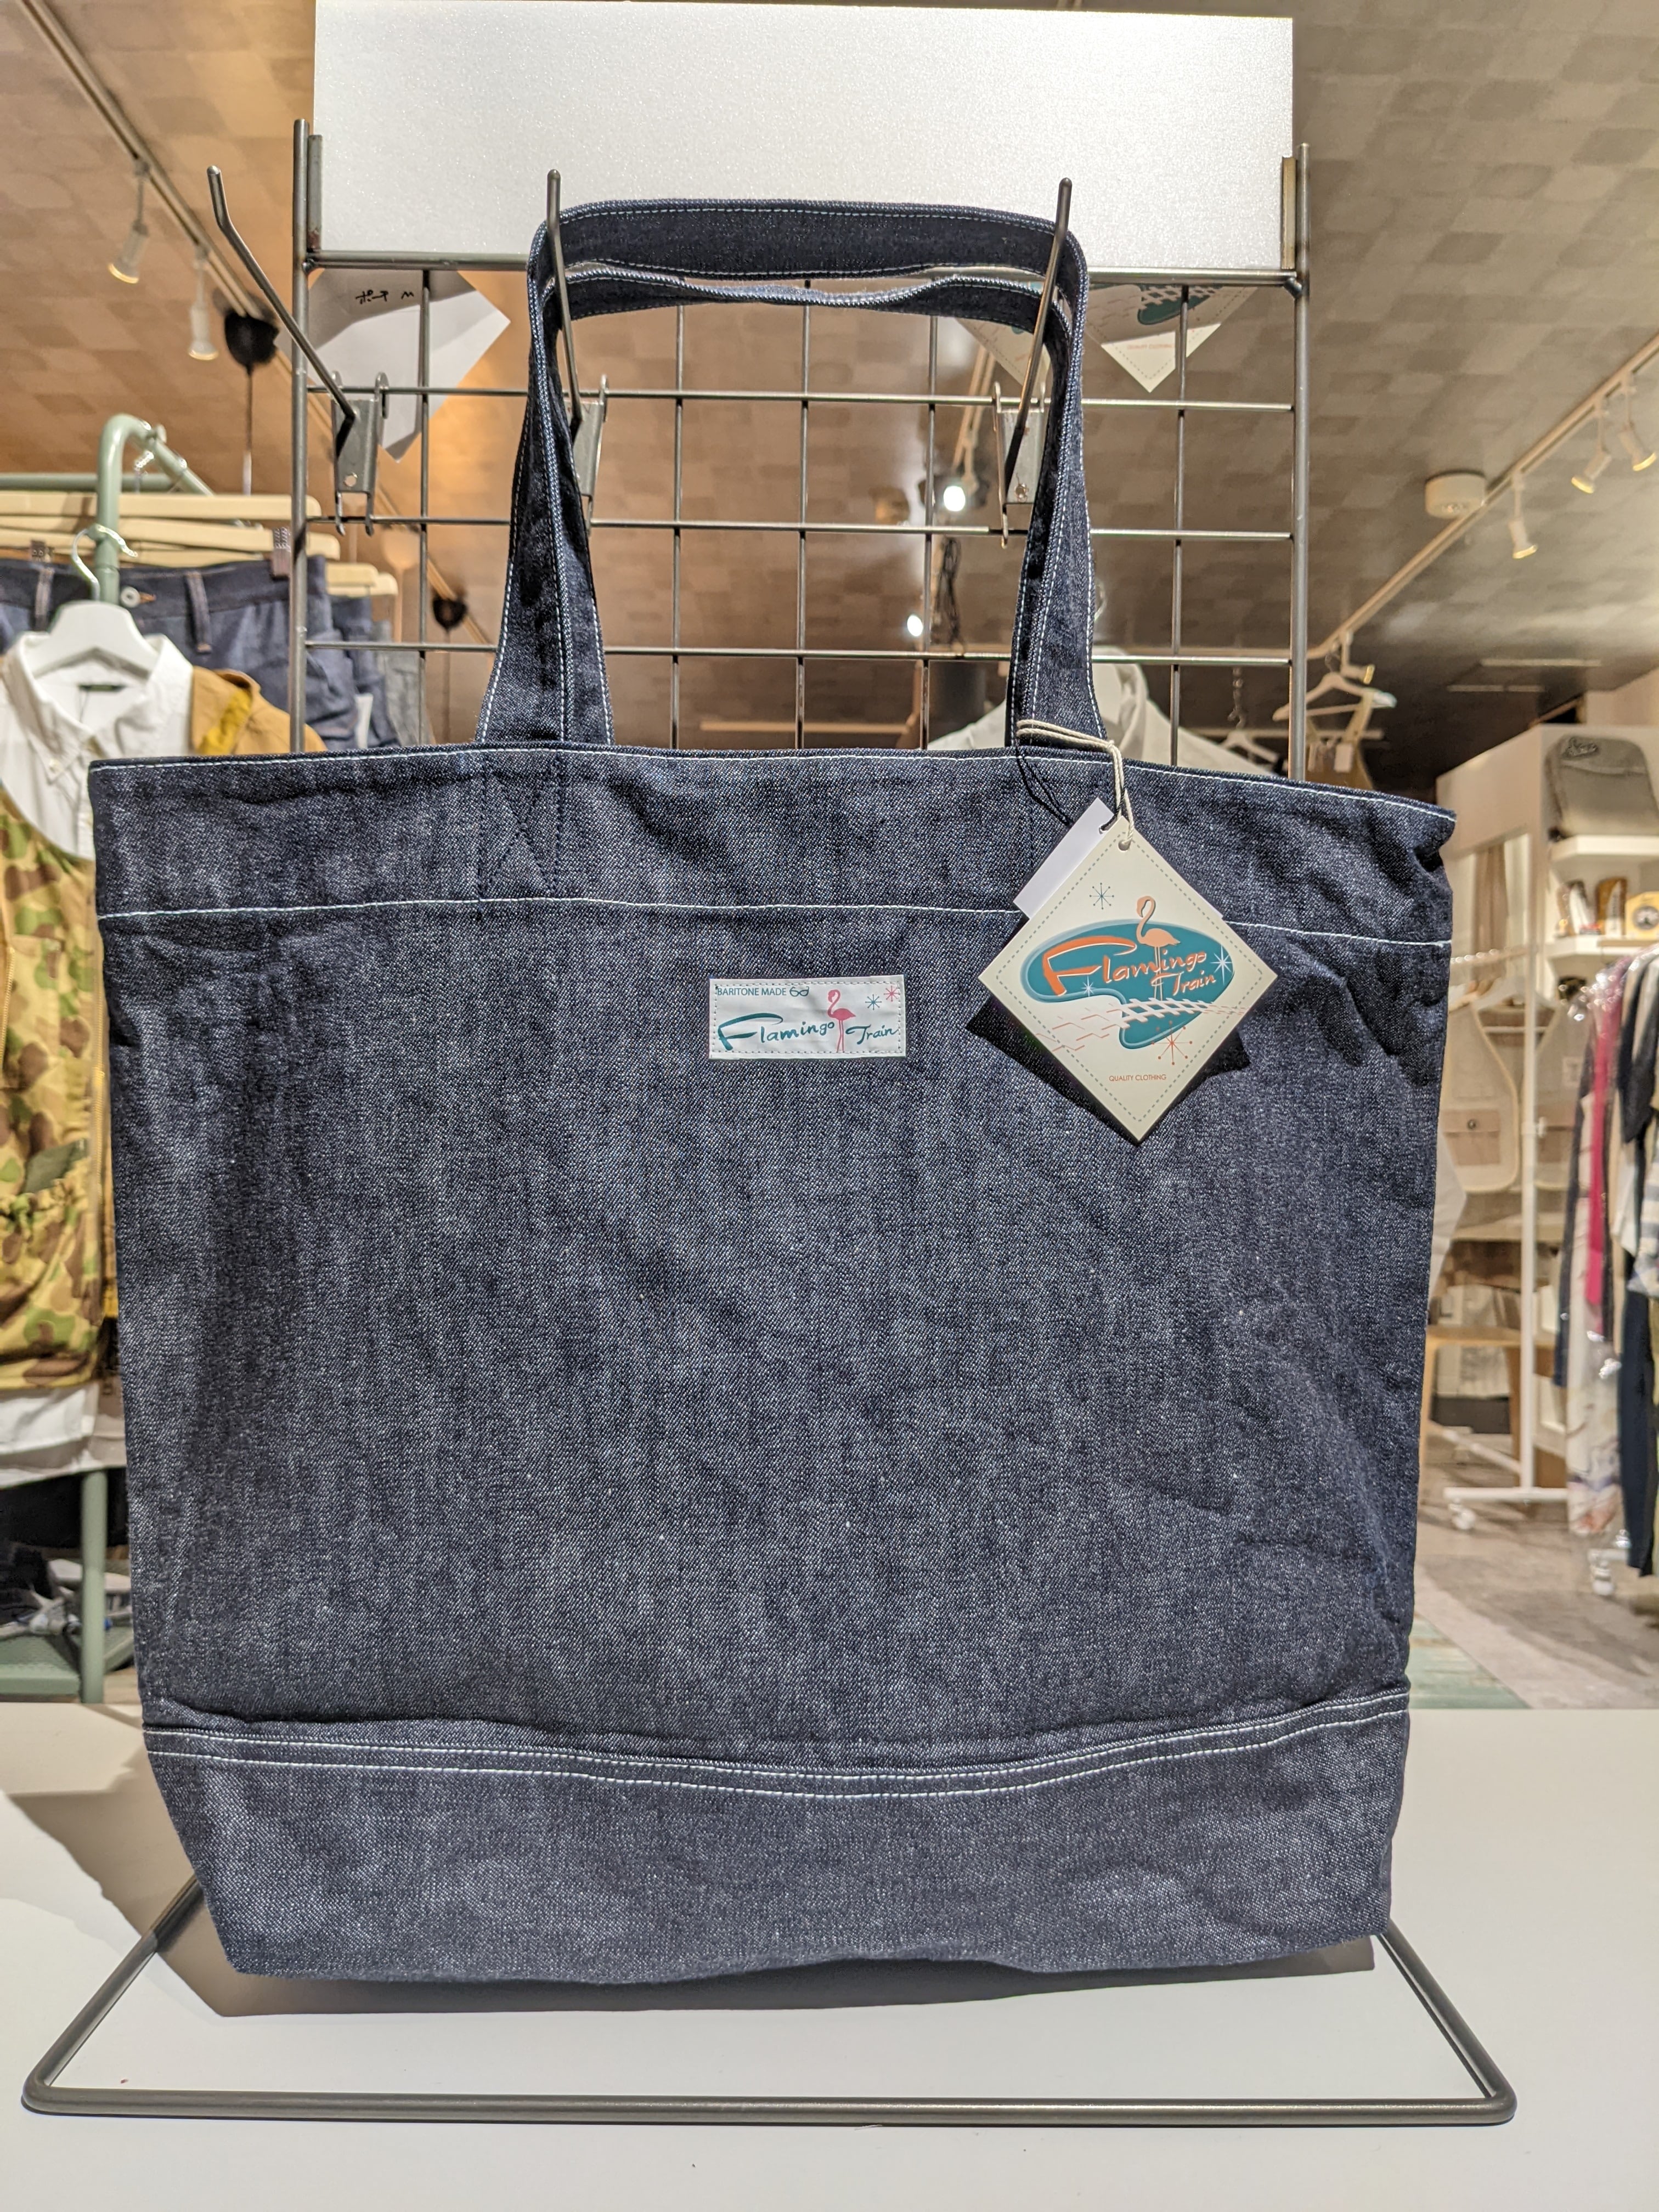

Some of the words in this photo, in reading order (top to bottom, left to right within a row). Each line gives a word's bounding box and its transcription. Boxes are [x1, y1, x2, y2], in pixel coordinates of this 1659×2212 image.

[1042, 935, 1207, 996] Flamingo
[717, 987, 759, 996] BARITONE
[761, 987, 787, 996] MADE
[1150, 970, 1216, 996] Train
[718, 1012, 835, 1051] Flamingo
[845, 1024, 899, 1045] Train
